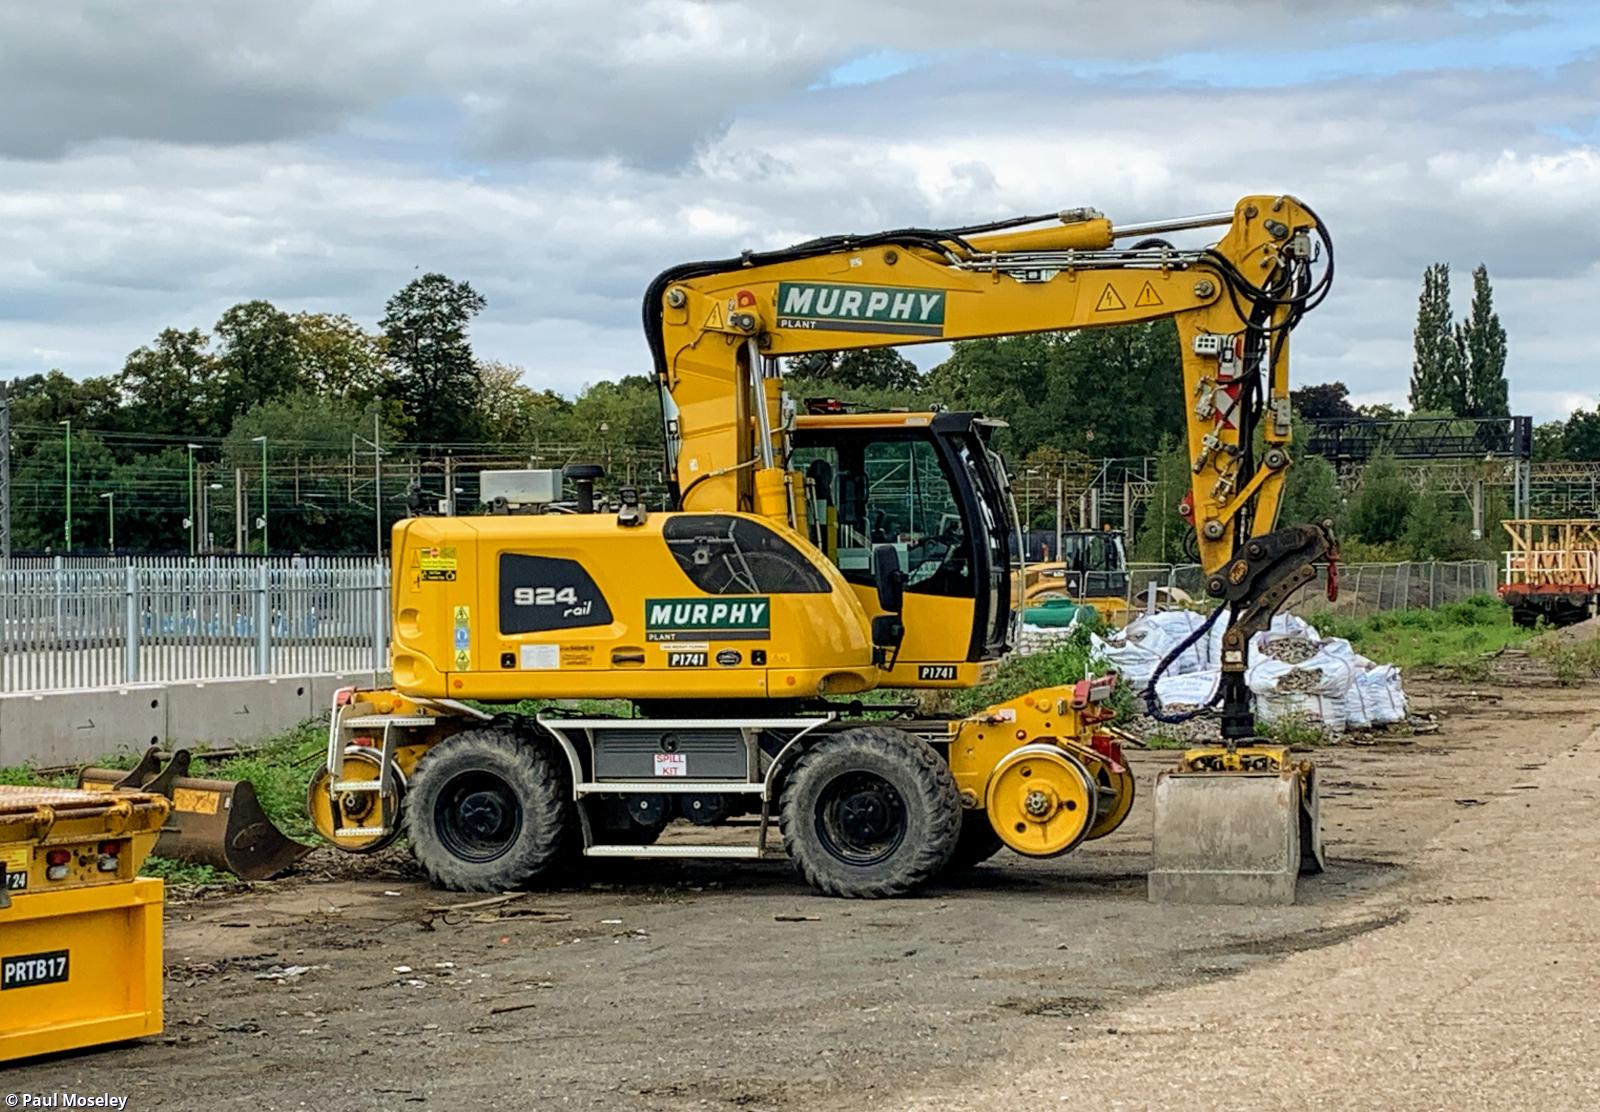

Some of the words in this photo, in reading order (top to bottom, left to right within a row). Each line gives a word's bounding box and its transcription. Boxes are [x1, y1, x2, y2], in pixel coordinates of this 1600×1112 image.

[783, 287, 941, 321] MURPHY
[780, 319, 817, 329] PLANT
[514, 587, 578, 606] 924
[563, 600, 592, 617] rail
[649, 603, 766, 625] MURPHY
[648, 633, 676, 641] PLANT
[671, 653, 705, 666] P1741
[921, 667, 954, 679] P1741
[656, 754, 684, 763] SPILL
[662, 766, 679, 776] KIT
[5, 956, 67, 983] PRTB17
